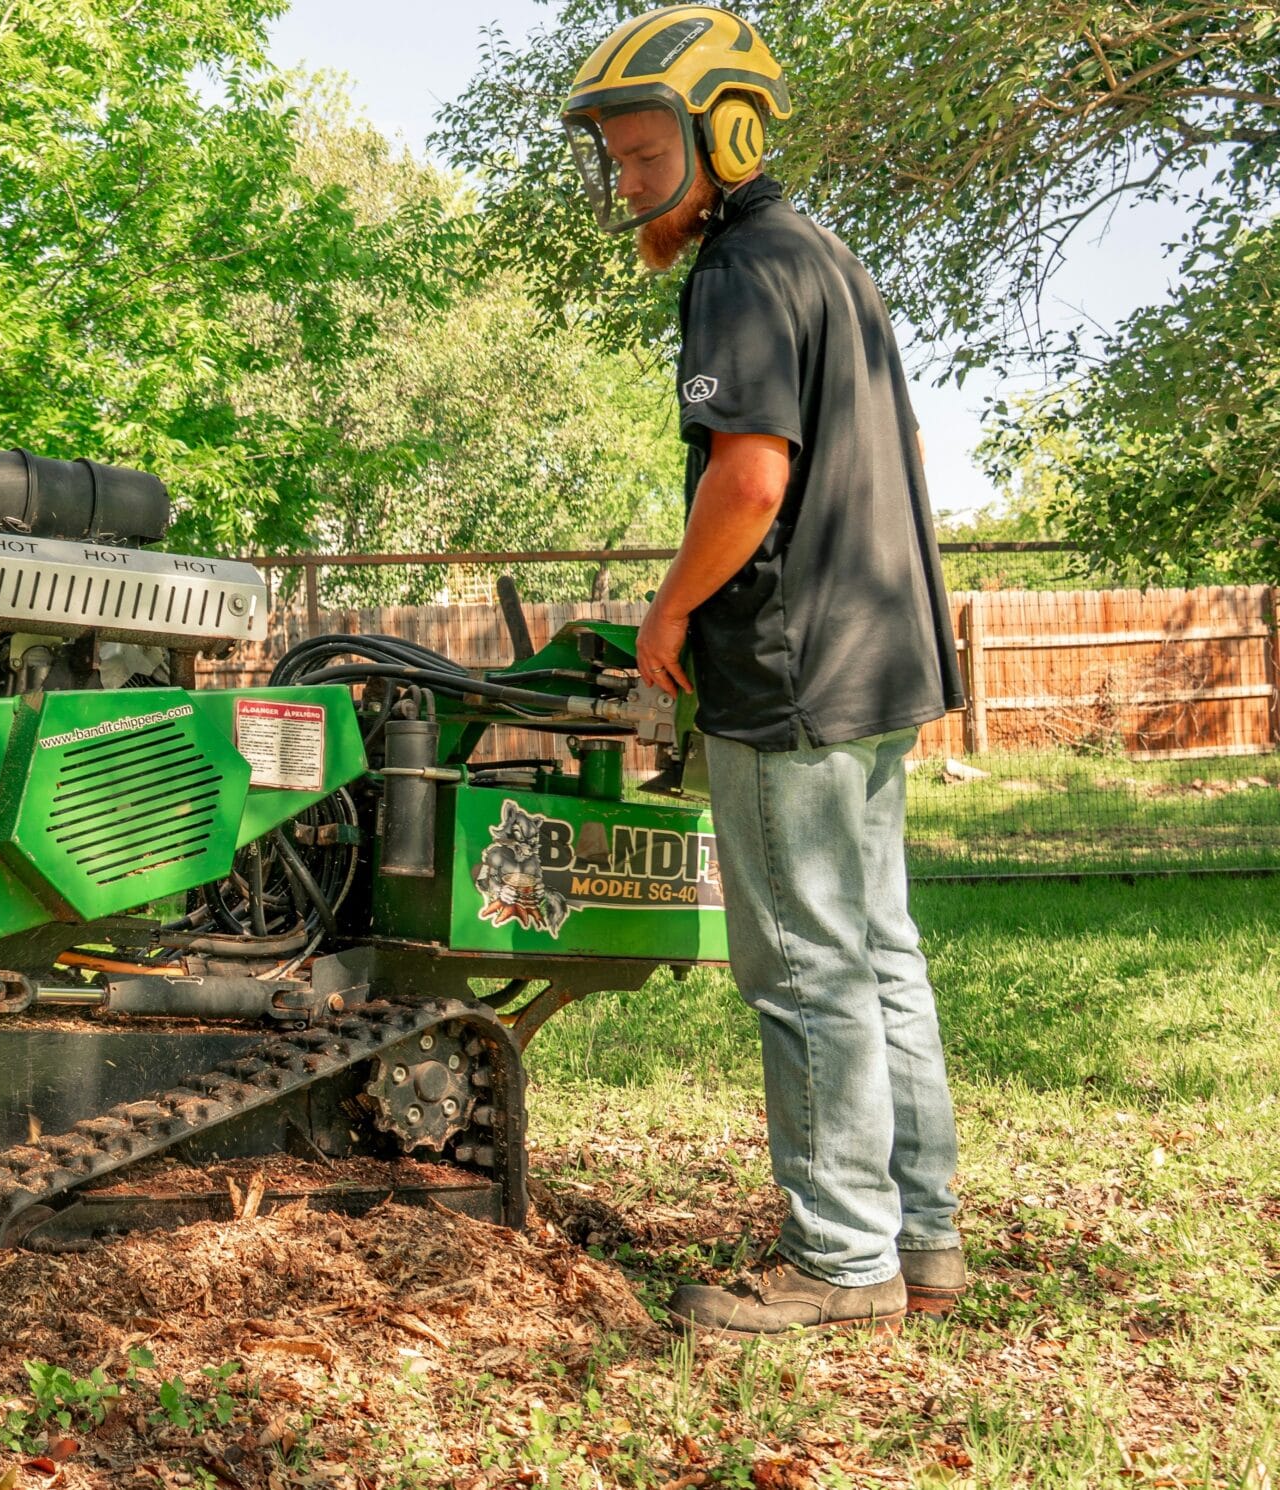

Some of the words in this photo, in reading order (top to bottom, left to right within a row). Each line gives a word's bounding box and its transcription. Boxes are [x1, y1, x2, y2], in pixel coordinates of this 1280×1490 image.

[660, 26, 704, 67] PROTOS
[84, 549, 130, 564] HOT
[173, 559, 218, 575] HOT
[250, 707, 279, 715] DANGER
[40, 704, 193, 748] www.banditchippers.com
[571, 877, 643, 899] MODEL
[648, 882, 697, 902] SG-40
